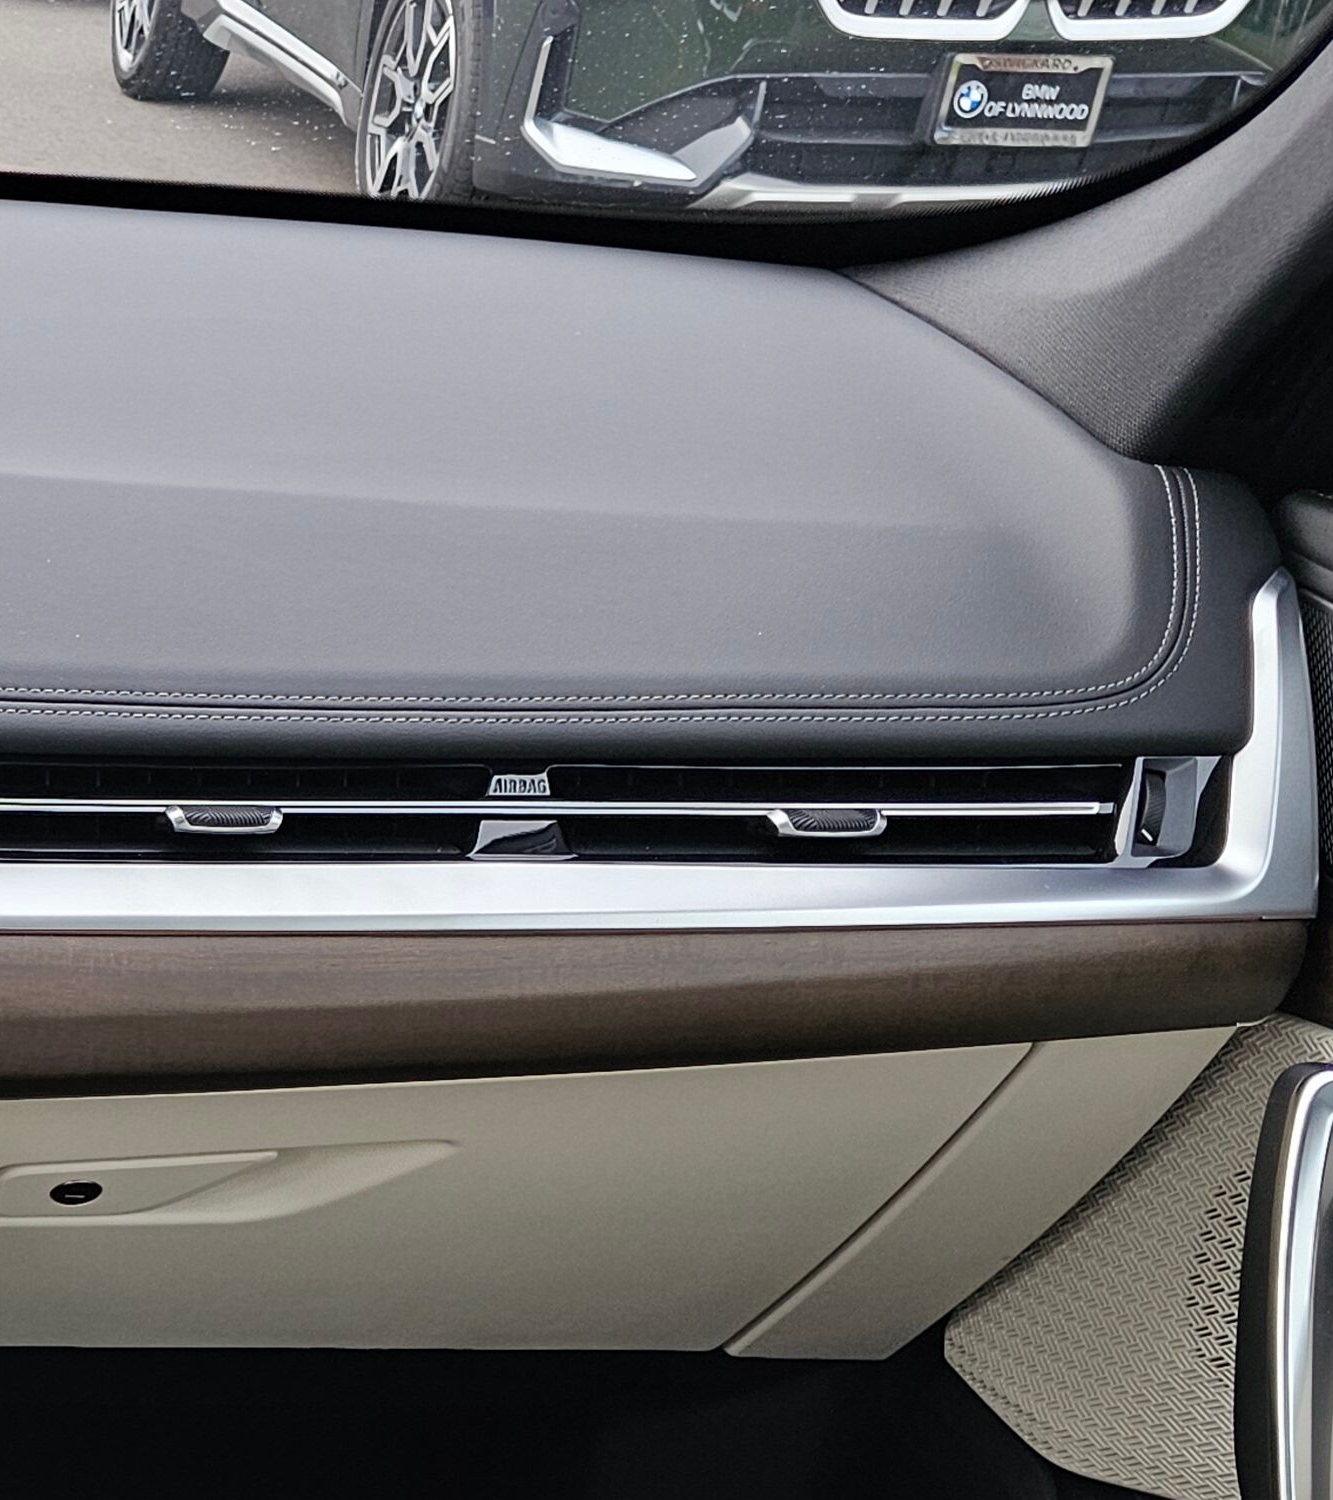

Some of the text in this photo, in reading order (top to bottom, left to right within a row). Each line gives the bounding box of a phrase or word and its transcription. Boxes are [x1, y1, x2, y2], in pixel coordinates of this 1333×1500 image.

[1022, 84, 1061, 100] BMW
[984, 101, 1089, 120] OF LYNNWOOD
[492, 777, 548, 795] AIRBAG
